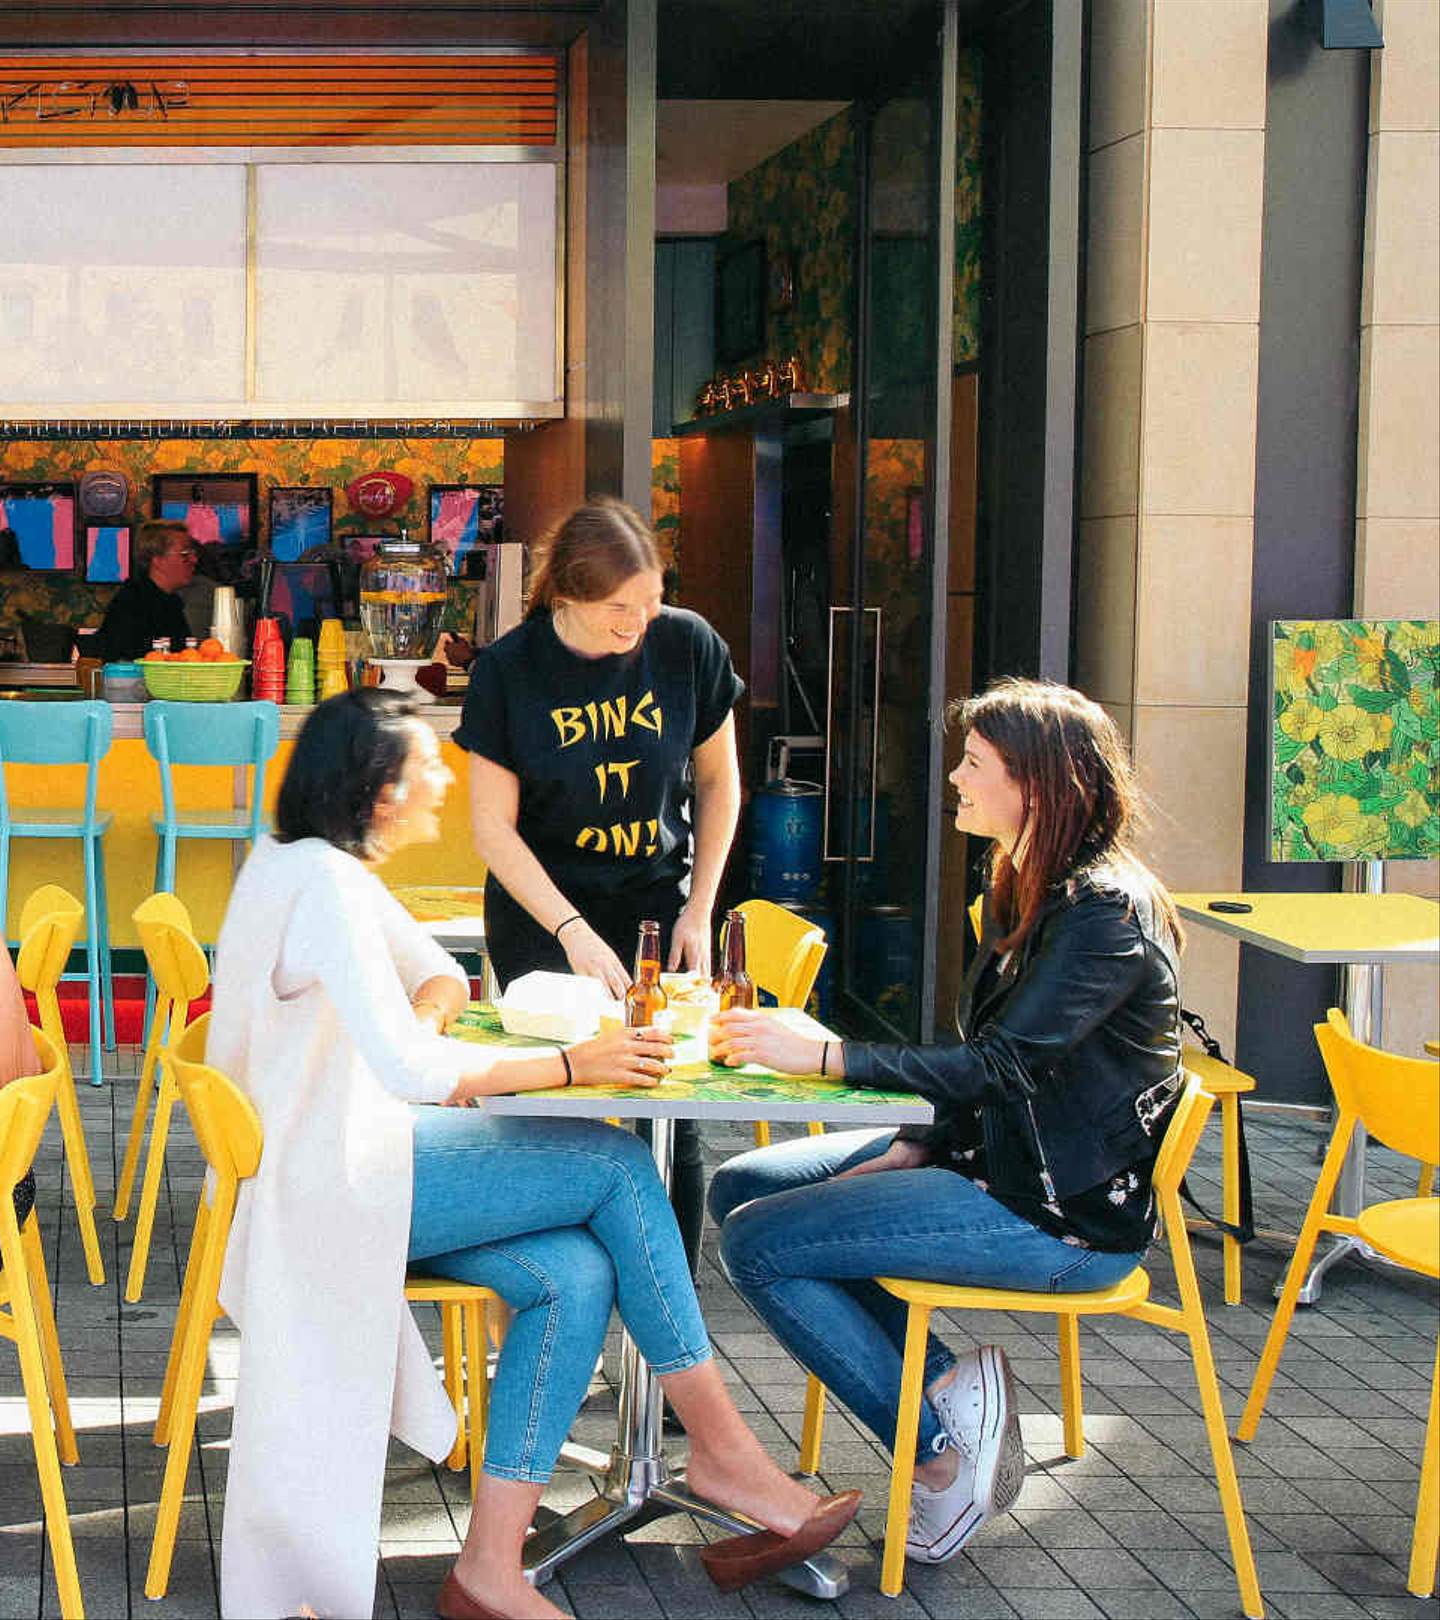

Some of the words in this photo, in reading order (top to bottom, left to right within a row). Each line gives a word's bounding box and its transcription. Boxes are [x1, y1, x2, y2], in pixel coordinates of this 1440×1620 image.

[550, 690, 663, 748] BING
[594, 759, 641, 804] IT
[575, 819, 658, 857] ON!
